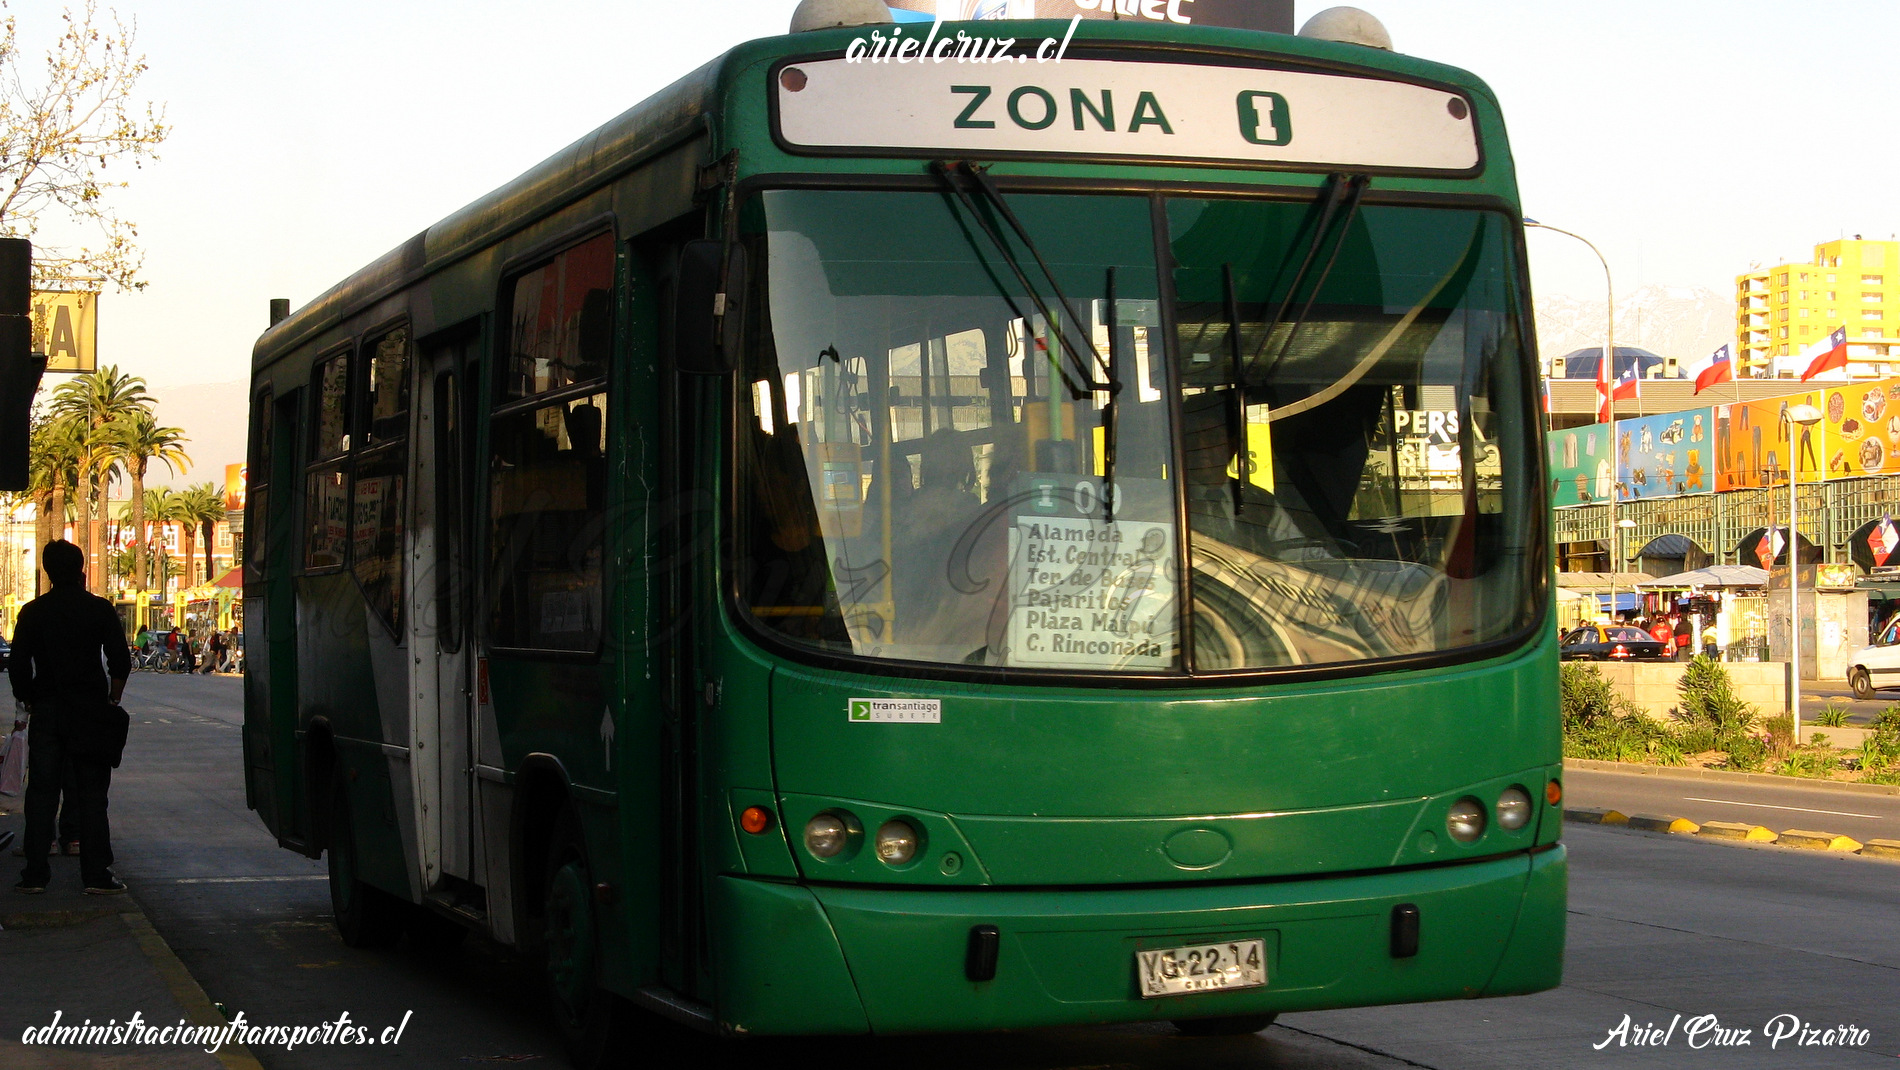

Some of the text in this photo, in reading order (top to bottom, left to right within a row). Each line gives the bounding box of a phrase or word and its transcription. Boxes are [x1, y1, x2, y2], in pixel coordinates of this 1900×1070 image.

[950, 85, 1175, 135] ZONA
[1028, 523, 1123, 543] Alameda
[1027, 544, 1142, 566] Est. Central
[1027, 567, 1065, 585] Ter.
[1070, 568, 1093, 586] de
[1028, 589, 1131, 614] Pajaritos
[1026, 610, 1083, 630] Plaza
[1027, 633, 1162, 658] C. Rinconada
[873, 702, 938, 713] transantiago
